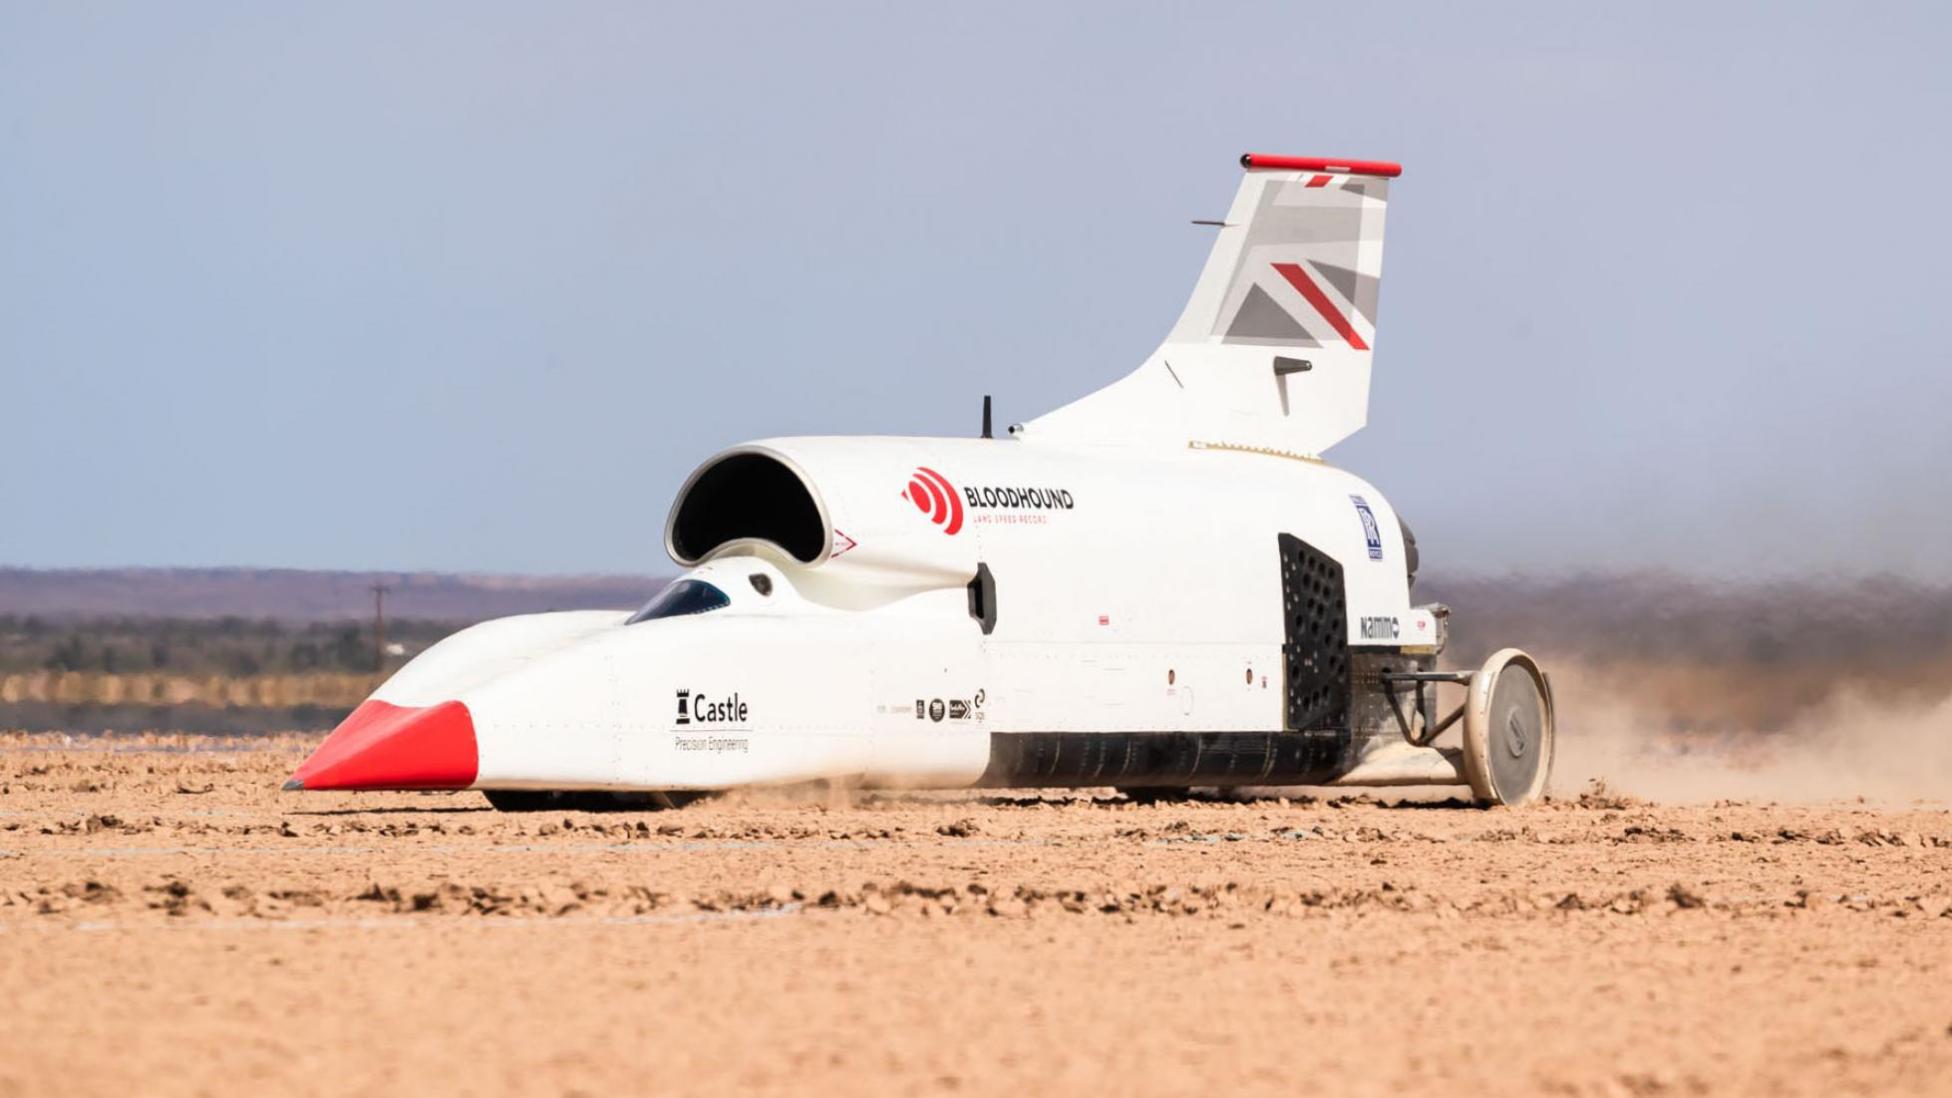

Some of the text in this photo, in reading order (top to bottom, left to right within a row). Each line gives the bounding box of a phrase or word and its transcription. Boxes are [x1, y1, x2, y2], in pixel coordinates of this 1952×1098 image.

[963, 486, 1074, 510] BLOODHOUND
[694, 692, 748, 722] Castle
[675, 736, 748, 754] Precision Engineering
